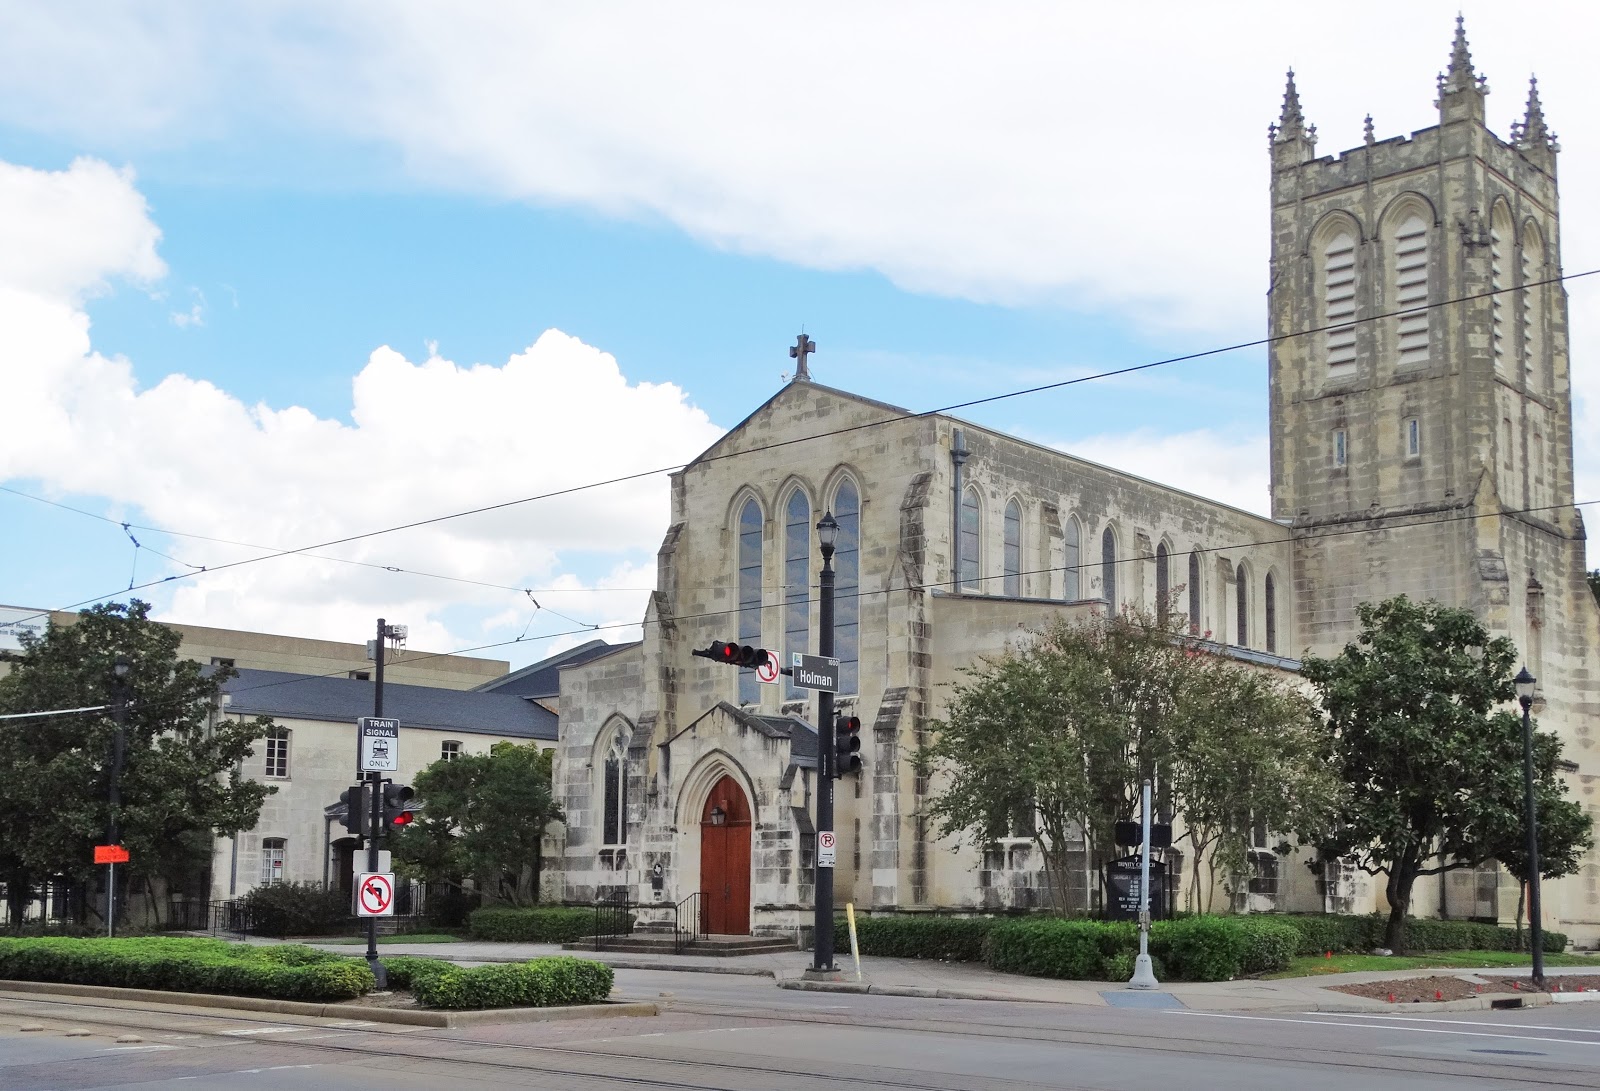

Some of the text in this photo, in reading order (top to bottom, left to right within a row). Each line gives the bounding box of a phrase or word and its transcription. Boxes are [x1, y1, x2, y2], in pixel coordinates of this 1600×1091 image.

[800, 669, 832, 687] Holman
[369, 720, 393, 728] TRAIN
[366, 728, 395, 737] SIGNAL
[369, 760, 390, 768] ONLY
